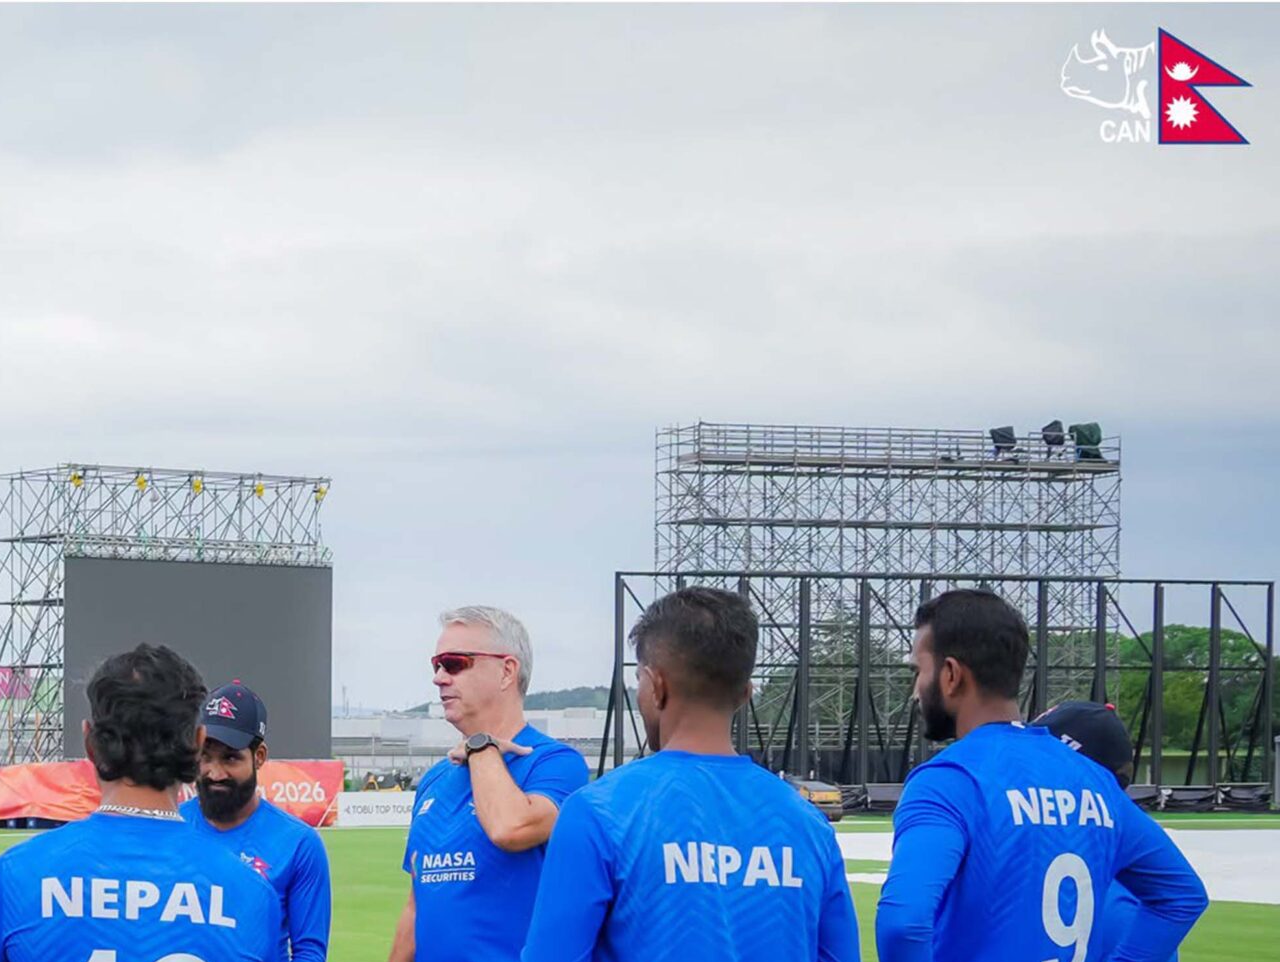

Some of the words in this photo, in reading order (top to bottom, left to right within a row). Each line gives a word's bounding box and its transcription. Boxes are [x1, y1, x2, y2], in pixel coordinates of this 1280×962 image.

[271, 781, 326, 802] 2026
[352, 805, 374, 814] TOBU
[376, 805, 391, 814] TOP
[1005, 787, 1115, 829] NEPAL
[422, 851, 476, 869] NAASA
[662, 841, 803, 888] NEPAL
[420, 871, 476, 883] SECURITIES
[41, 876, 237, 928] NEPAL
